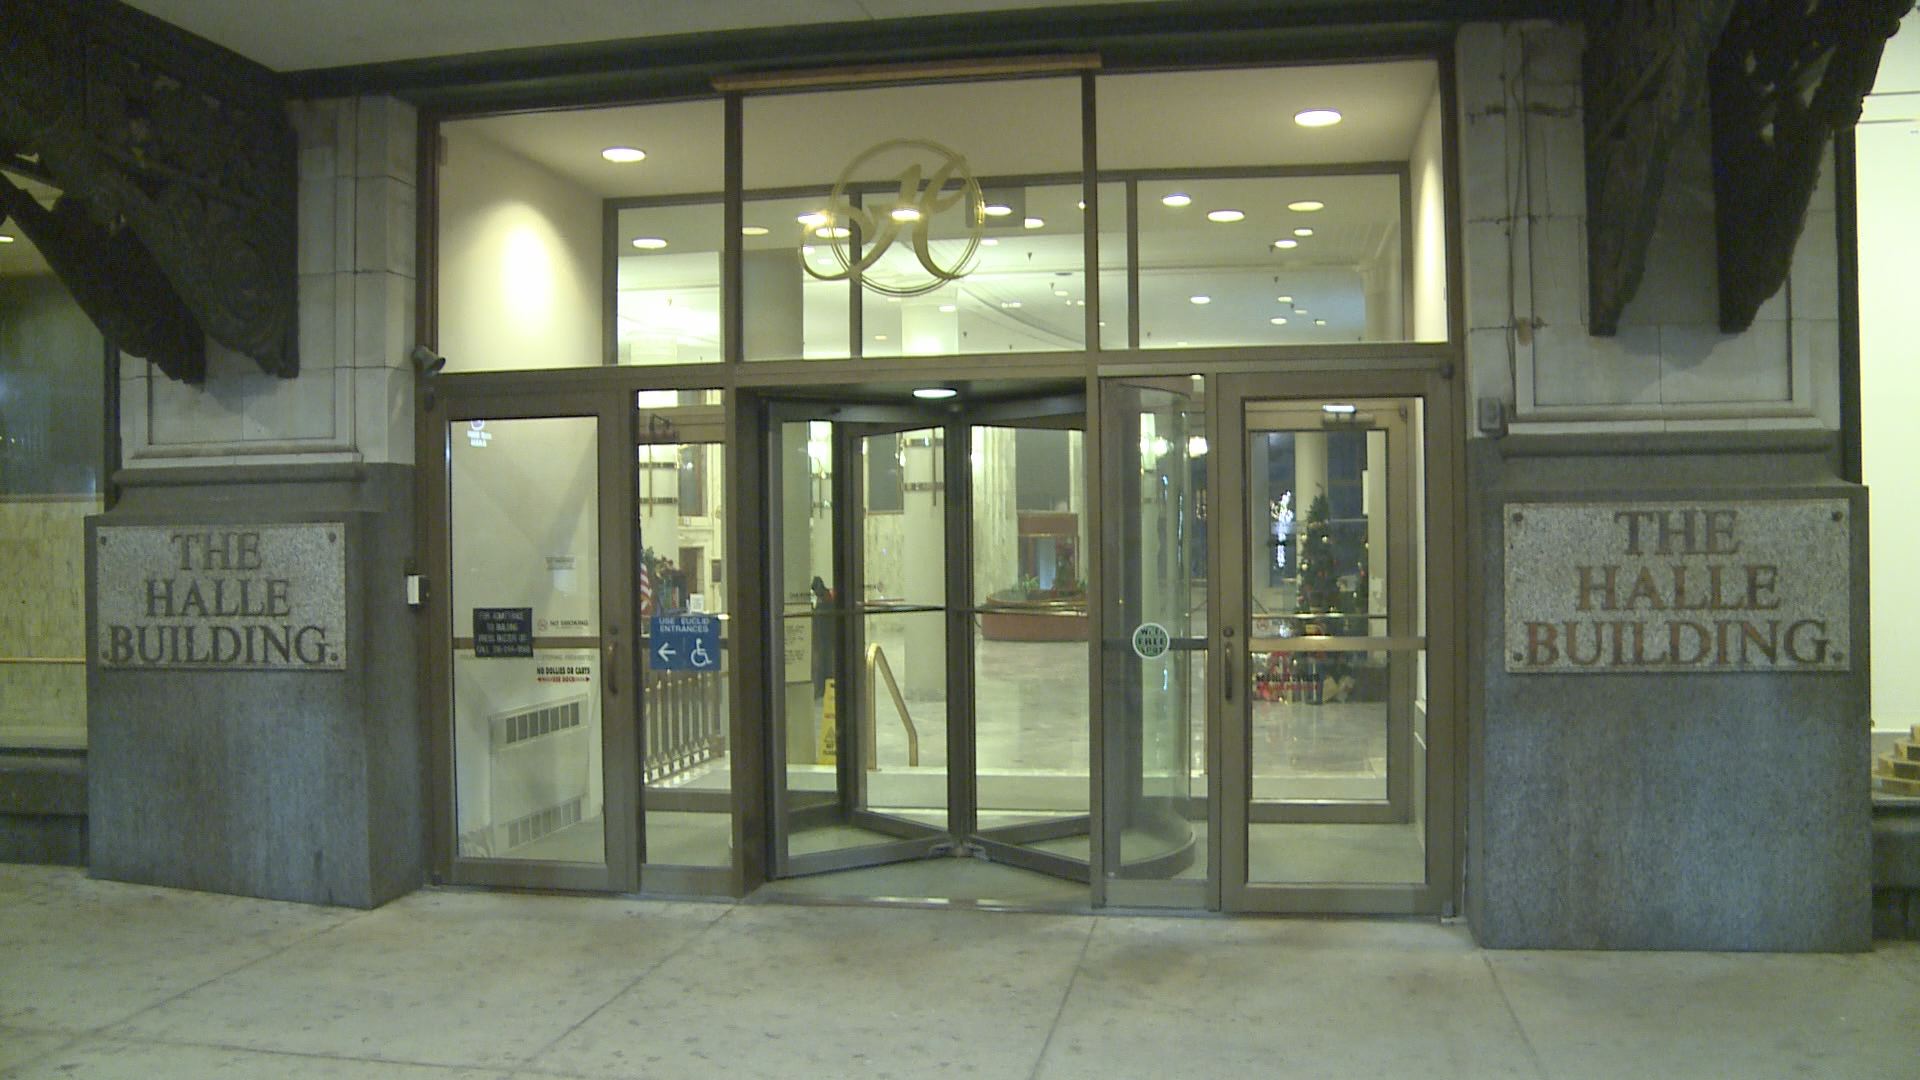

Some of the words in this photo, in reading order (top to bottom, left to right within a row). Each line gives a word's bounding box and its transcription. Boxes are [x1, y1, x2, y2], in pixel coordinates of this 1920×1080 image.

[171, 532, 263, 570] THE
[1613, 509, 1743, 556] THE
[146, 577, 292, 617] HALLE
[1575, 564, 1781, 611] HALLE
[658, 617, 674, 625] USE
[680, 617, 710, 625] EUCLID
[659, 624, 710, 633] ENTRANCES
[108, 624, 330, 665] BUILDING
[1524, 619, 1830, 665] BUILDING
[537, 666, 545, 675] NO
[546, 666, 566, 675] DOLLIES
[567, 666, 574, 675] OR
[575, 666, 591, 675] CARTS
